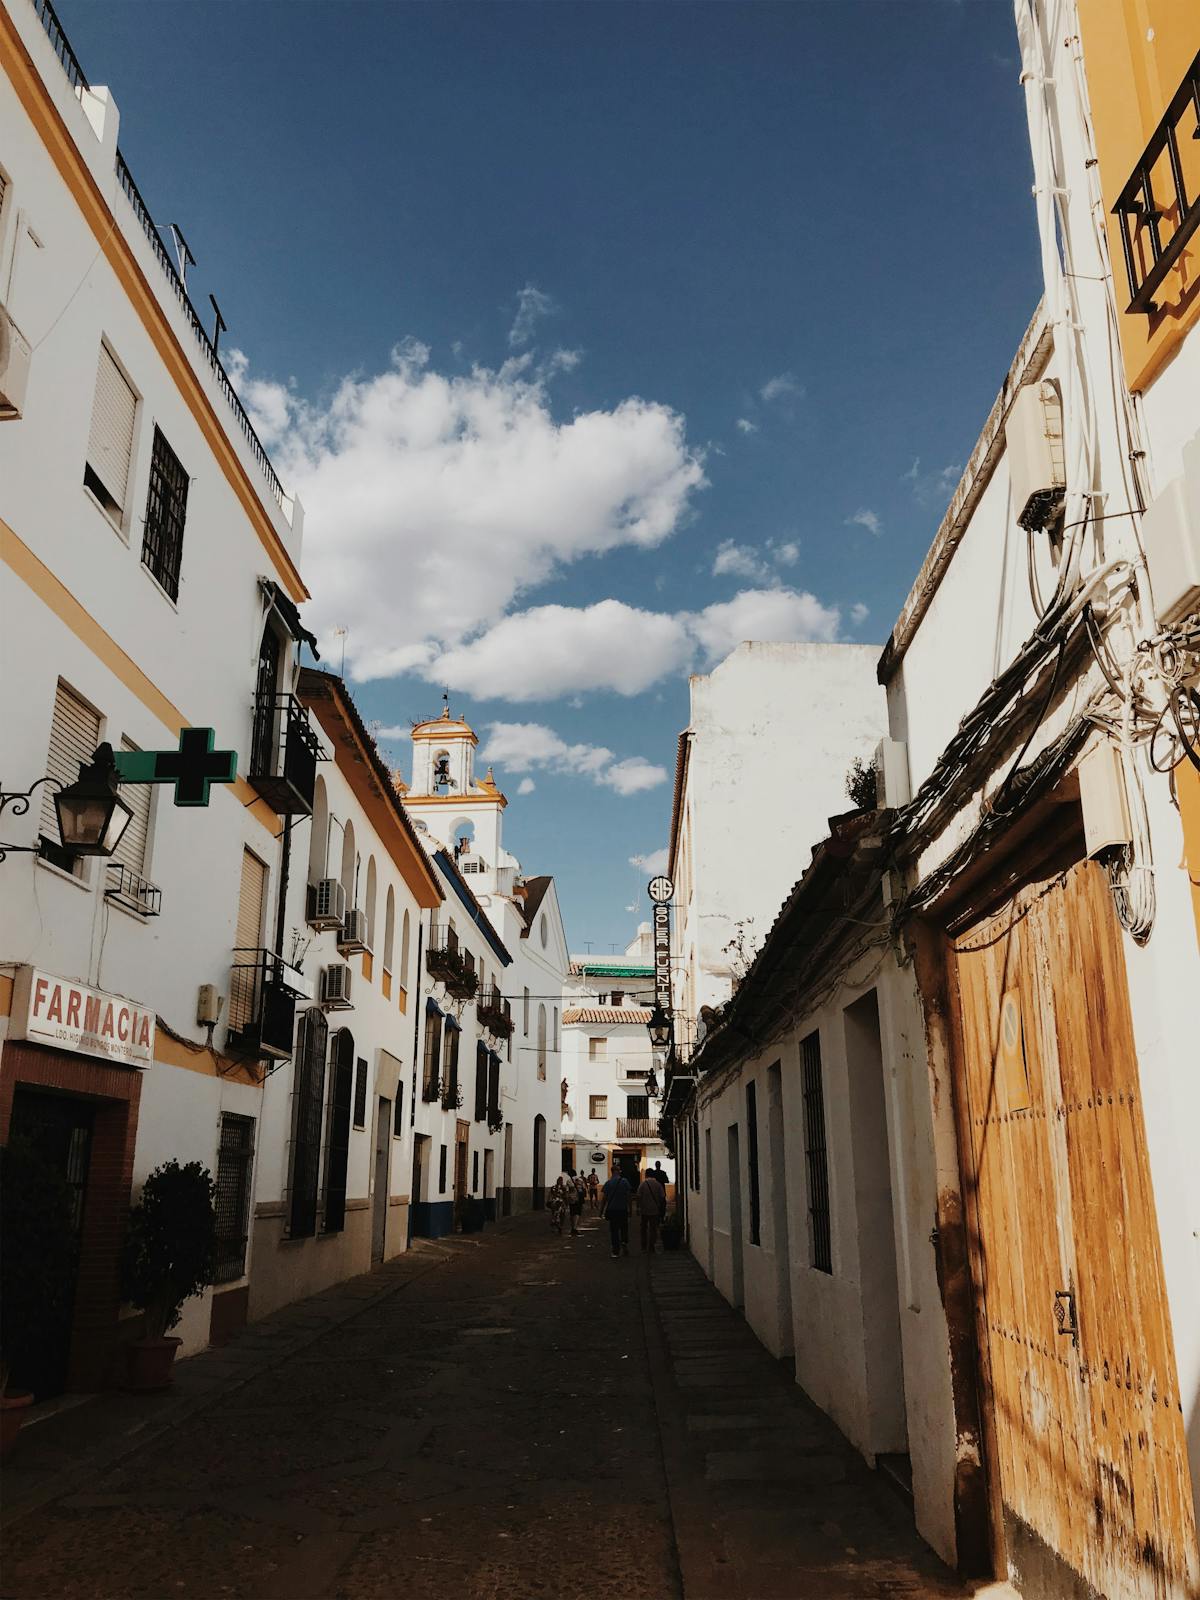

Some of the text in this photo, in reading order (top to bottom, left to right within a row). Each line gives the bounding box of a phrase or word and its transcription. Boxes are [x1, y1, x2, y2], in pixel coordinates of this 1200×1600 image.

[655, 906, 670, 1008] SOLER FUENTES
[33, 977, 150, 1048] FARMACIA
